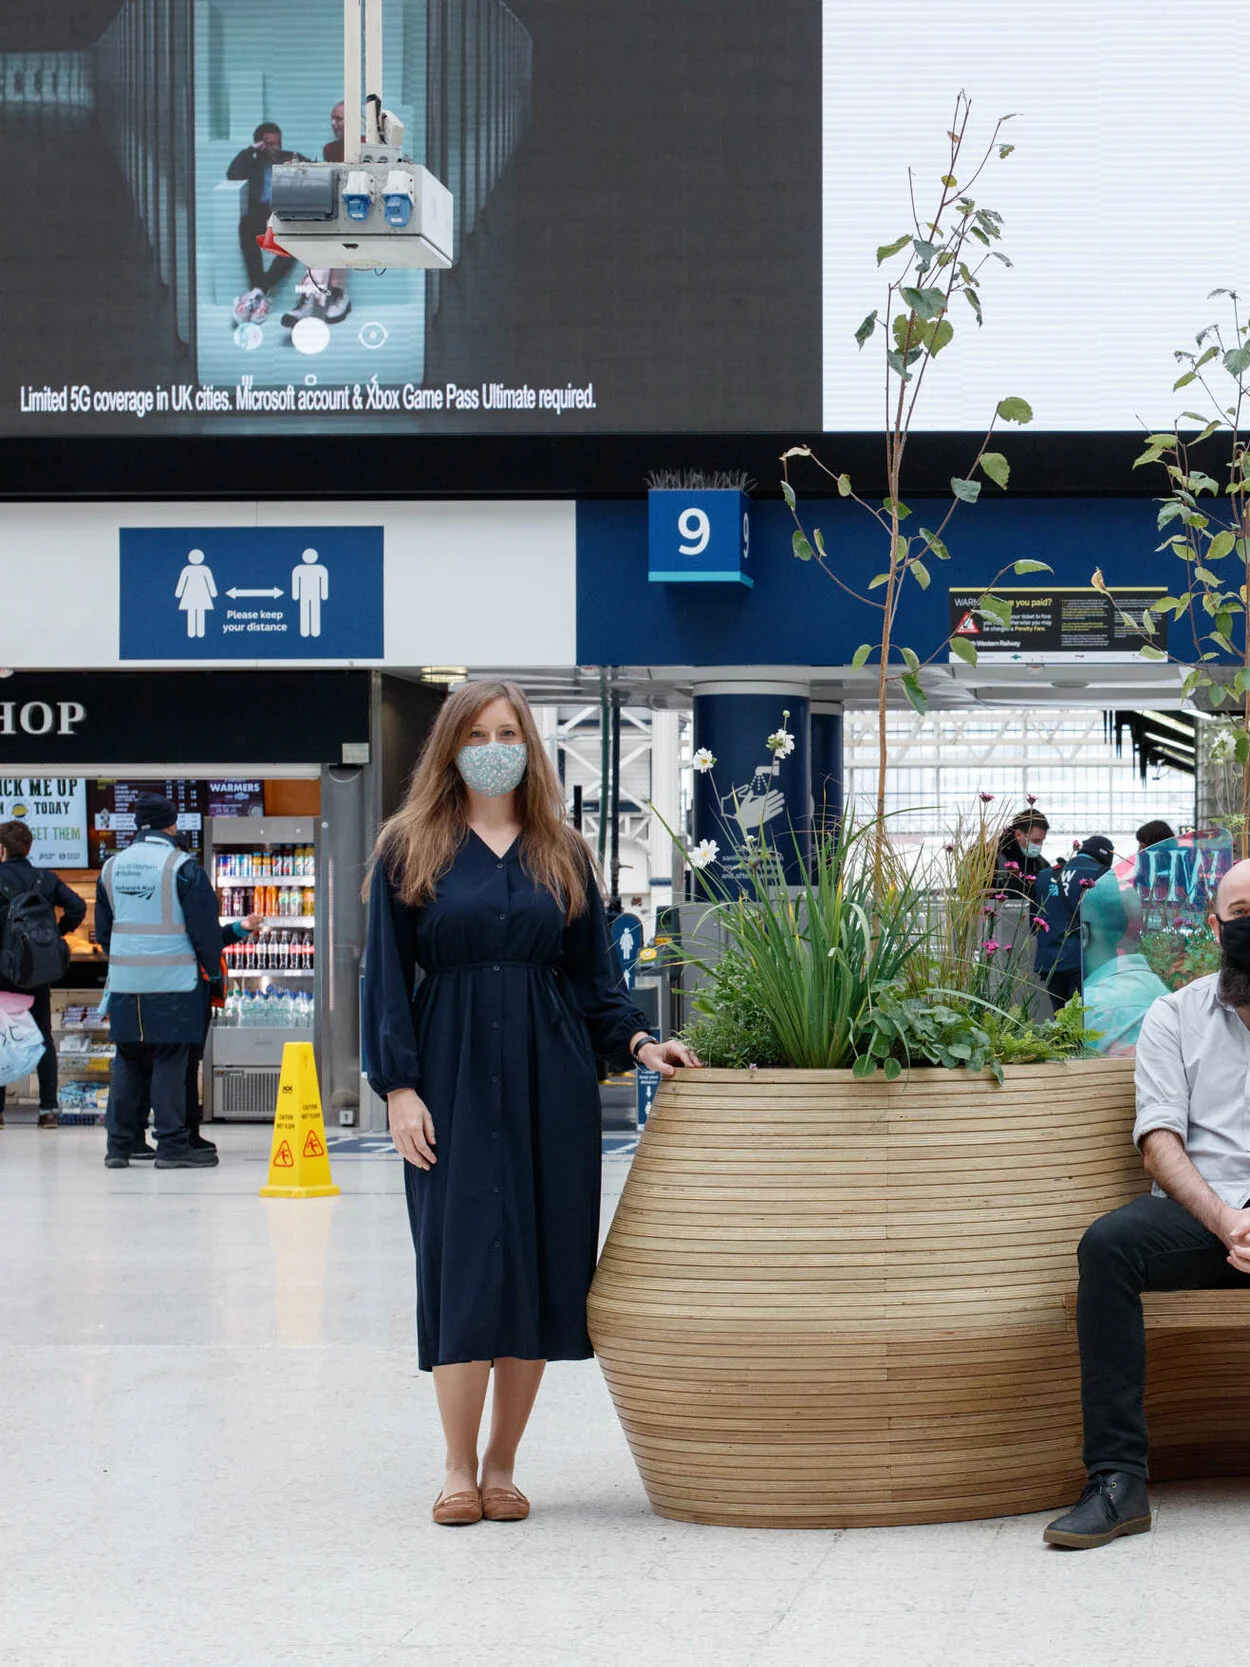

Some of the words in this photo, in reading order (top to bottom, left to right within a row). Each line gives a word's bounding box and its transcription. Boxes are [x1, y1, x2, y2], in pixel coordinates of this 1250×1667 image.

[20, 385, 68, 412] Limited
[70, 385, 91, 411] 5G
[93, 386, 155, 417] coverage
[156, 385, 169, 411] in
[171, 384, 194, 411] UK
[195, 384, 233, 411] cities.
[235, 384, 296, 411] Microsoft
[297, 386, 350, 410] account
[352, 384, 364, 410] &
[365, 383, 400, 410] Xbox
[402, 383, 443, 410] Game
[446, 383, 480, 410] Pass
[482, 383, 537, 410] Ultimate
[538, 383, 597, 415] required.
[677, 507, 711, 556] 9
[742, 511, 750, 559] 9
[954, 598, 980, 607] WARN
[1015, 599, 1030, 608] you
[1031, 598, 1053, 609] paid?
[226, 610, 259, 620] Please
[260, 610, 284, 621] keep
[222, 623, 246, 634] your
[246, 622, 288, 632] distance
[29, 779, 52, 797] ME
[57, 779, 78, 797] UP
[209, 783, 261, 793] WARMERS
[34, 801, 71, 815] TODAY
[52, 827, 81, 841] THEM
